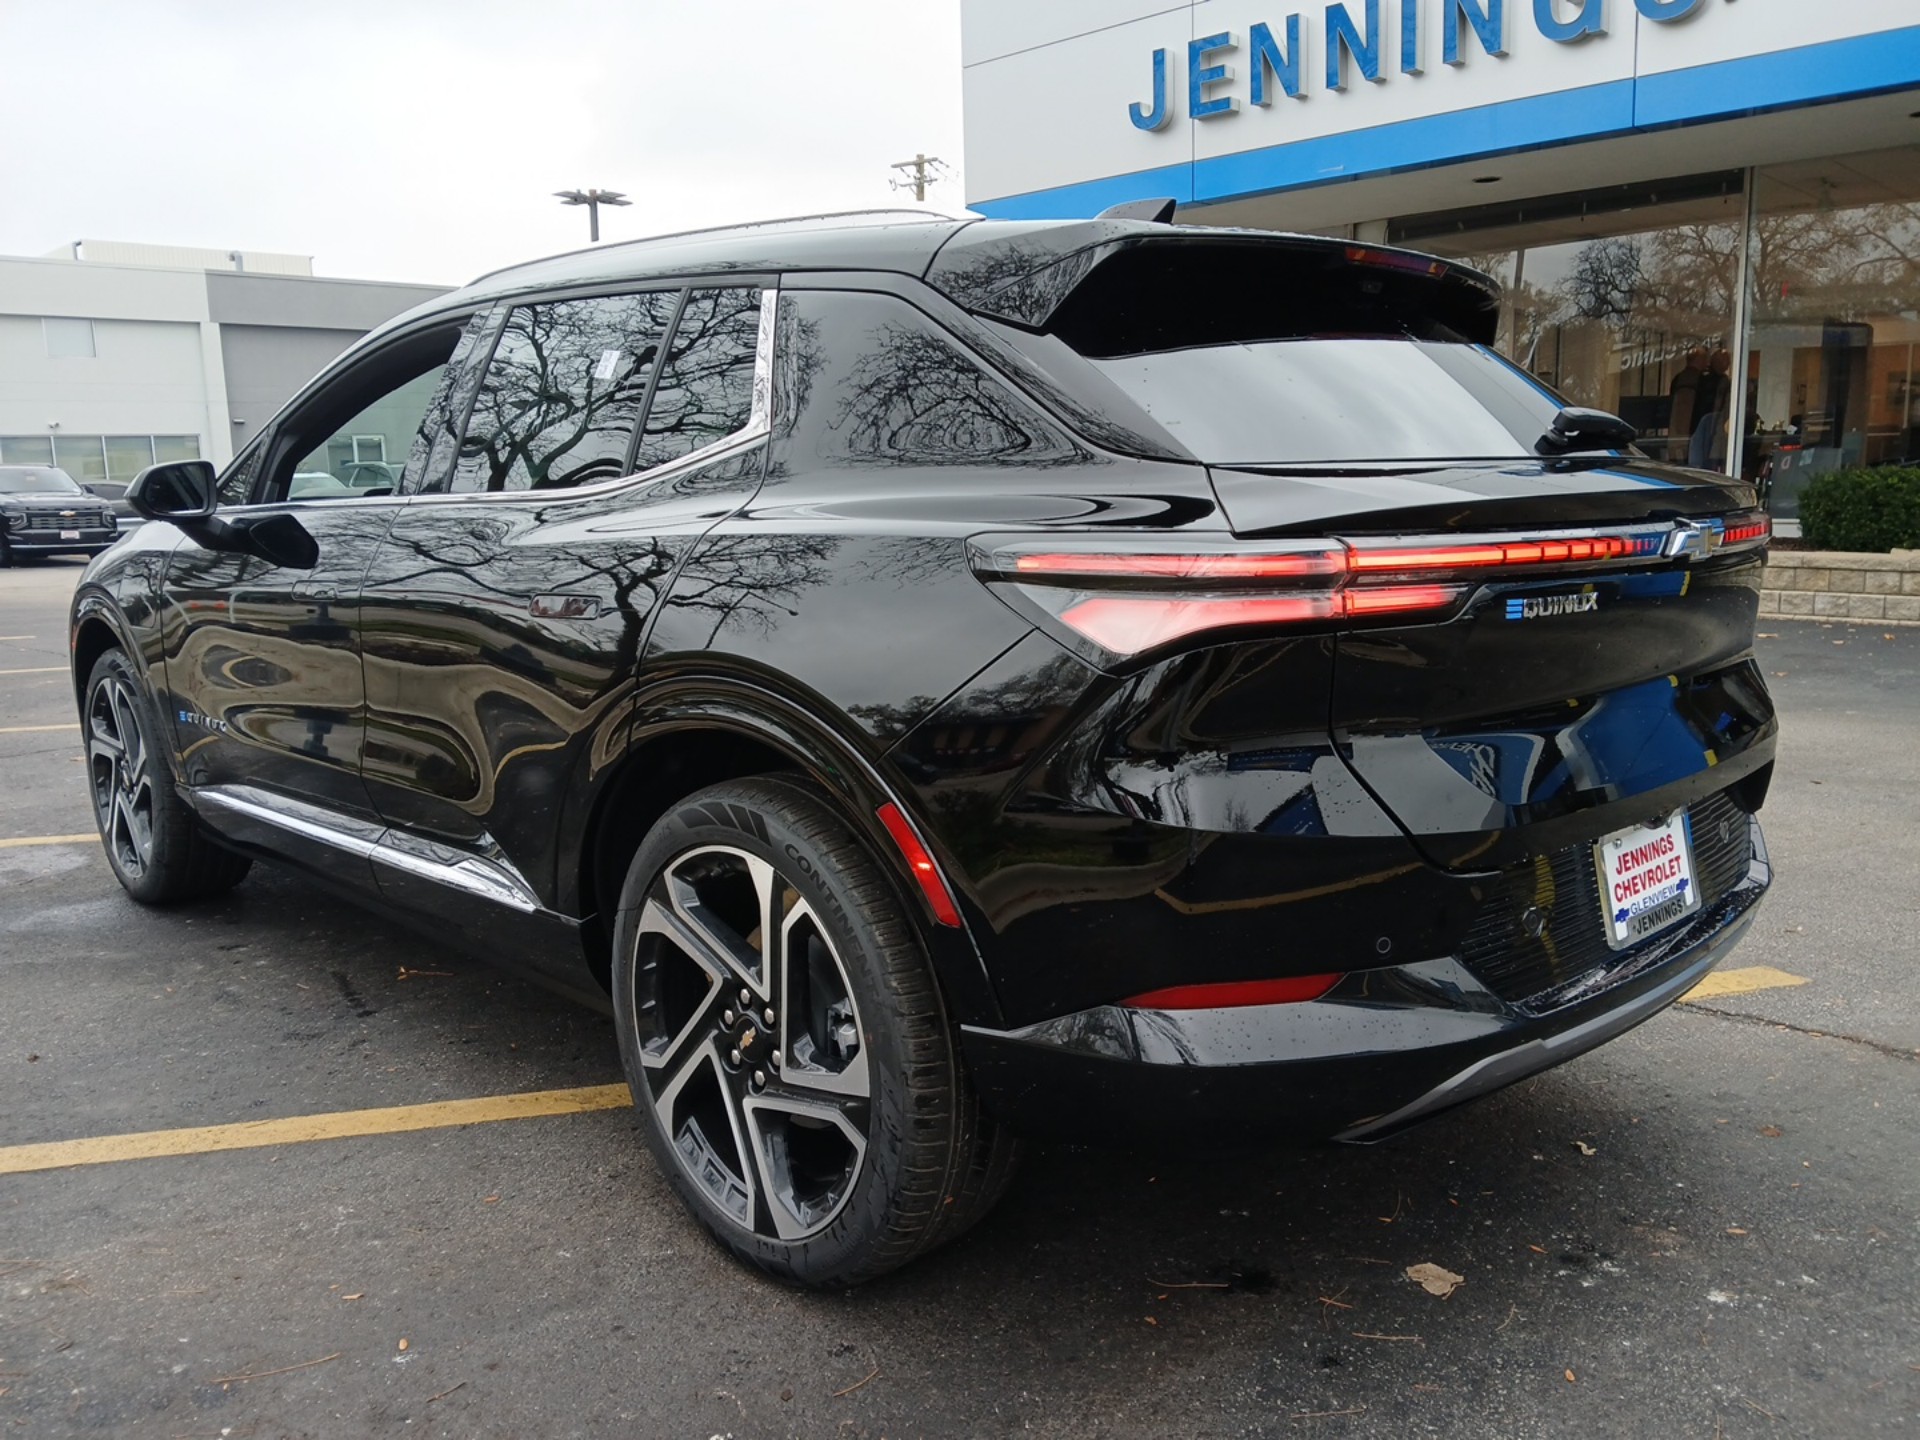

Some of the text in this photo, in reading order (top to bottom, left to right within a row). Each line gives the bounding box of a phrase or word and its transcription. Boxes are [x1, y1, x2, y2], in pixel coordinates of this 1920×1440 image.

[1128, 0, 1706, 131] JENNIN
[1505, 591, 1598, 619] EQUINOX
[1615, 834, 1674, 876] JENNINGS
[1614, 855, 1681, 903] CHEVROLET
[1630, 883, 1676, 915] GLENVIEW
[1637, 899, 1684, 935] JENNINGS
